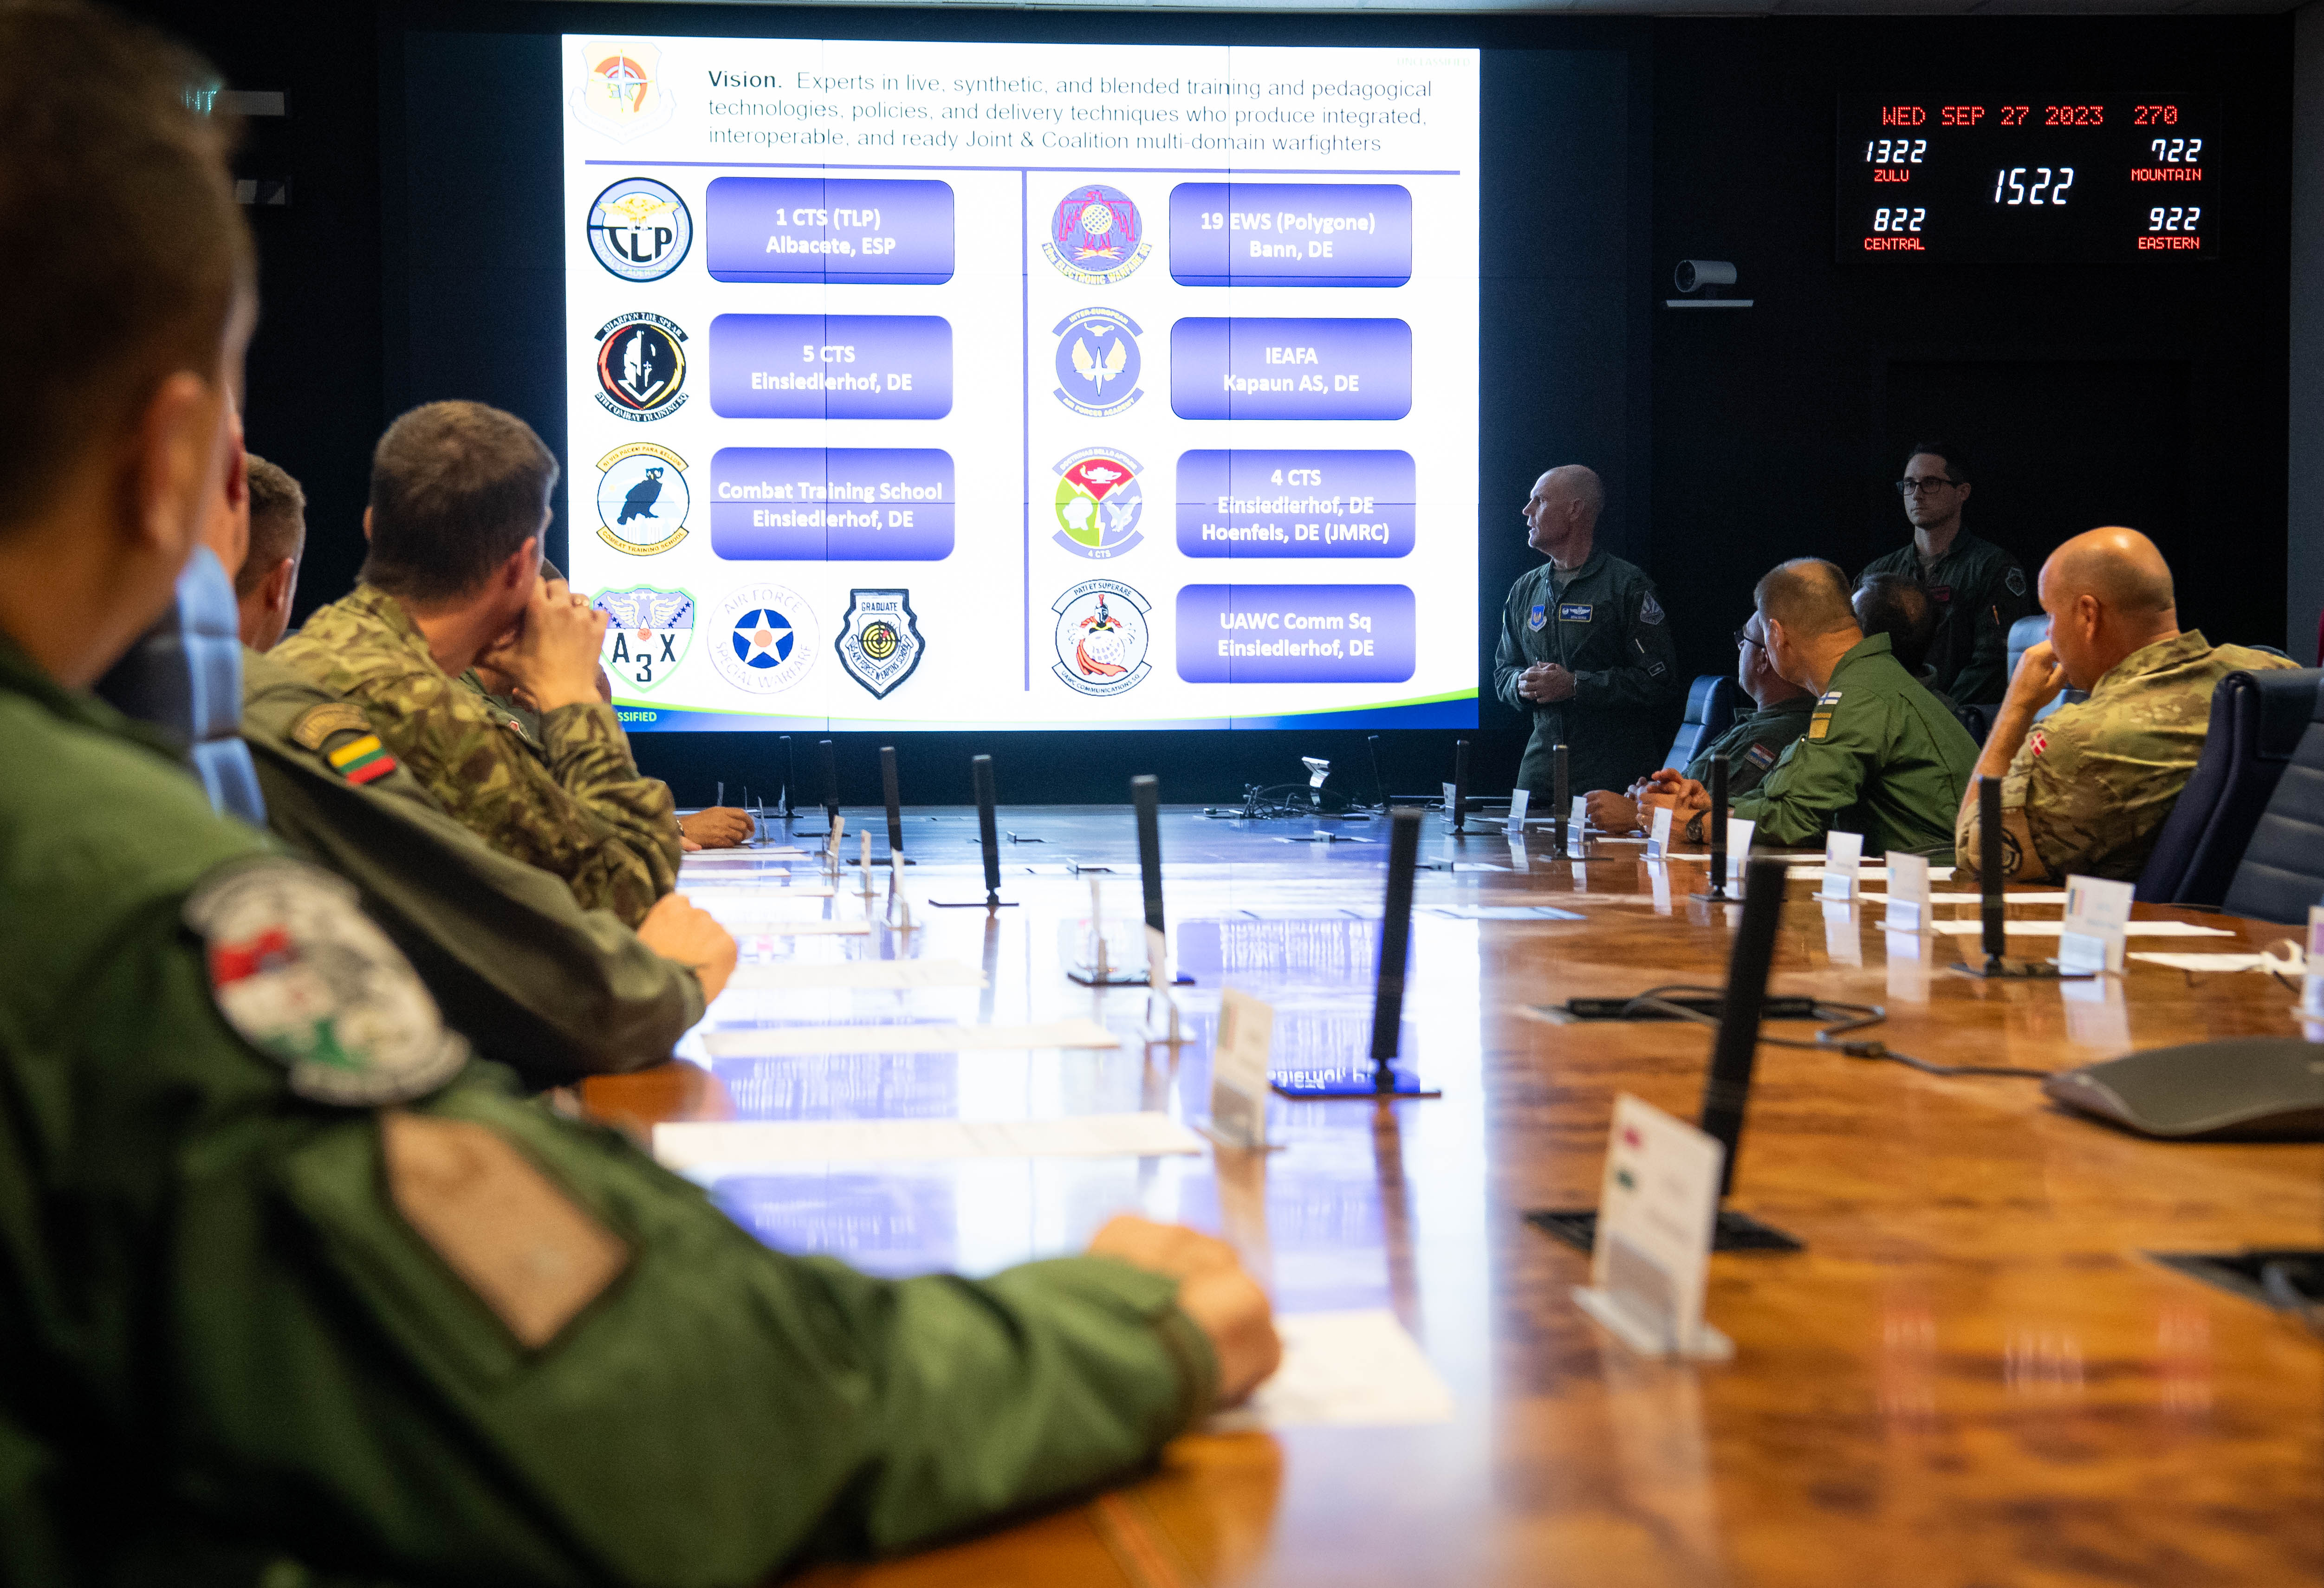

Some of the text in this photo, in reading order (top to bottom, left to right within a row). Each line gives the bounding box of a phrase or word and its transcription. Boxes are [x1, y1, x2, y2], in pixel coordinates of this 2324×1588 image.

[708, 70, 1431, 101] Vision. Experts in live, synthetic, and blended training and pedagogical
[709, 99, 1426, 128] technologies, policies, and delivery techniques who produce integrated,
[1883, 104, 2178, 126] WED SEP 27 2023 270
[710, 128, 1381, 155] interoperable, and ready Joint & Coalition multi-domain warfighters
[1866, 139, 1927, 163] 1322
[2151, 138, 2203, 162] 722
[1874, 169, 1909, 182] ZULU
[2131, 168, 2202, 181] MOUNTAIN
[1995, 167, 2074, 205] 1522
[776, 208, 881, 231] 1 CTS (TLP)
[1201, 212, 1375, 234] 19 EWS (Polygone)
[1874, 207, 1926, 232] 822
[2149, 207, 2201, 231] 922
[602, 226, 673, 263] TLP
[766, 235, 896, 257] Albacete, ESP
[1250, 240, 1333, 260] Bann, DE
[1864, 237, 1925, 251] CENTRAL
[2138, 236, 2200, 250] EASTERN
[803, 345, 855, 363] 5 CTS
[1266, 347, 1318, 364] IEAFA
[752, 372, 912, 394] Einsiedlerhof, DE
[1224, 374, 1359, 395] Kapaun AS, DE
[1271, 469, 1321, 486] 4 CTS
[718, 481, 942, 503] Combat Training School
[1218, 495, 1374, 517] Einsiedlerhof, DE
[753, 509, 914, 531] Einsiedlerhof, DE
[1202, 523, 1389, 544] Hoenfels, DE (JMRC)
[1073, 584, 1089, 596] PATI
[1098, 582, 1132, 597] SUPERARE
[861, 602, 898, 612] GRADUATE
[1220, 613, 1371, 633] UAWC Comm Sq
[612, 632, 676, 663] A X
[1218, 639, 1374, 659] Einsiedlerhof, DE
[636, 654, 652, 682] 3
[716, 642, 753, 687] SPECIAL
[1061, 670, 1076, 686] UAWC
[1076, 680, 1133, 694] COMMUNICATIONS
[616, 711, 658, 722] SSIFIED
